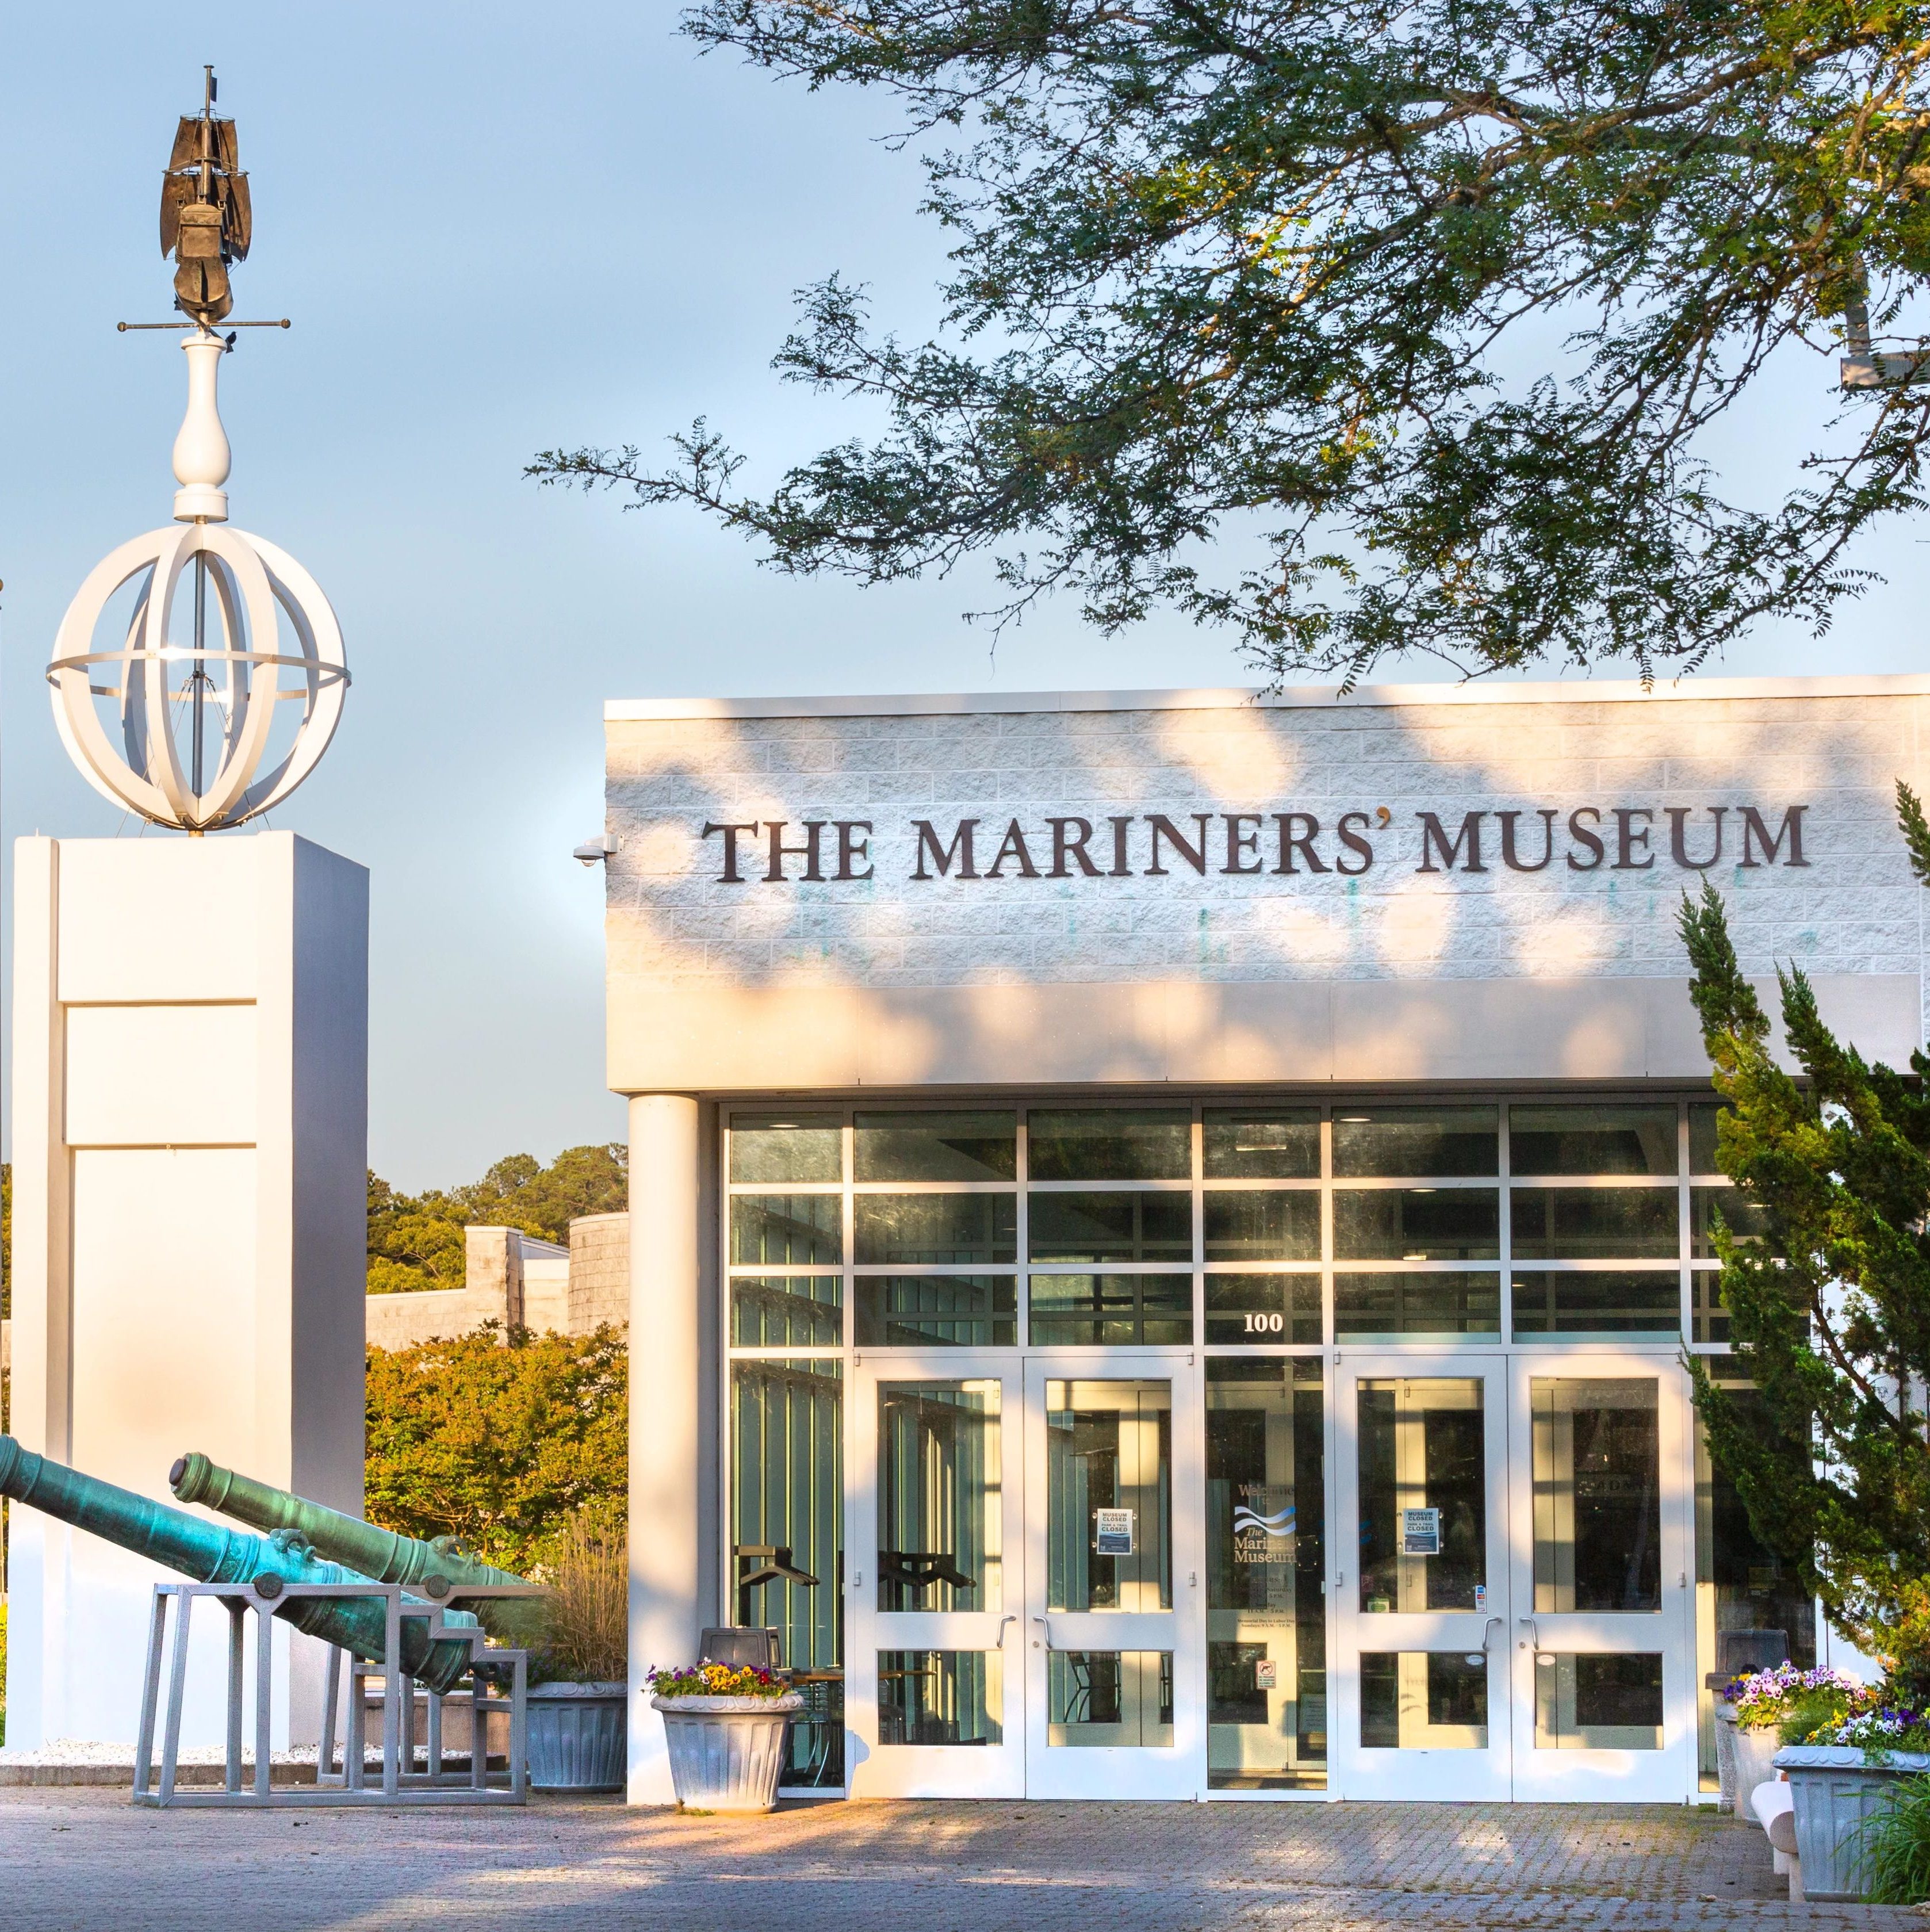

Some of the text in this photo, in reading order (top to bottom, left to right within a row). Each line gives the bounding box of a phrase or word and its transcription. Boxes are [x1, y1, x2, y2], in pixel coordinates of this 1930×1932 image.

[702, 821, 874, 883] THE
[1416, 806, 1810, 873] MUSEUM
[1244, 1313, 1283, 1332] 100
[1246, 1527, 1263, 1536] The
[1234, 1550, 1297, 1563] Museum
